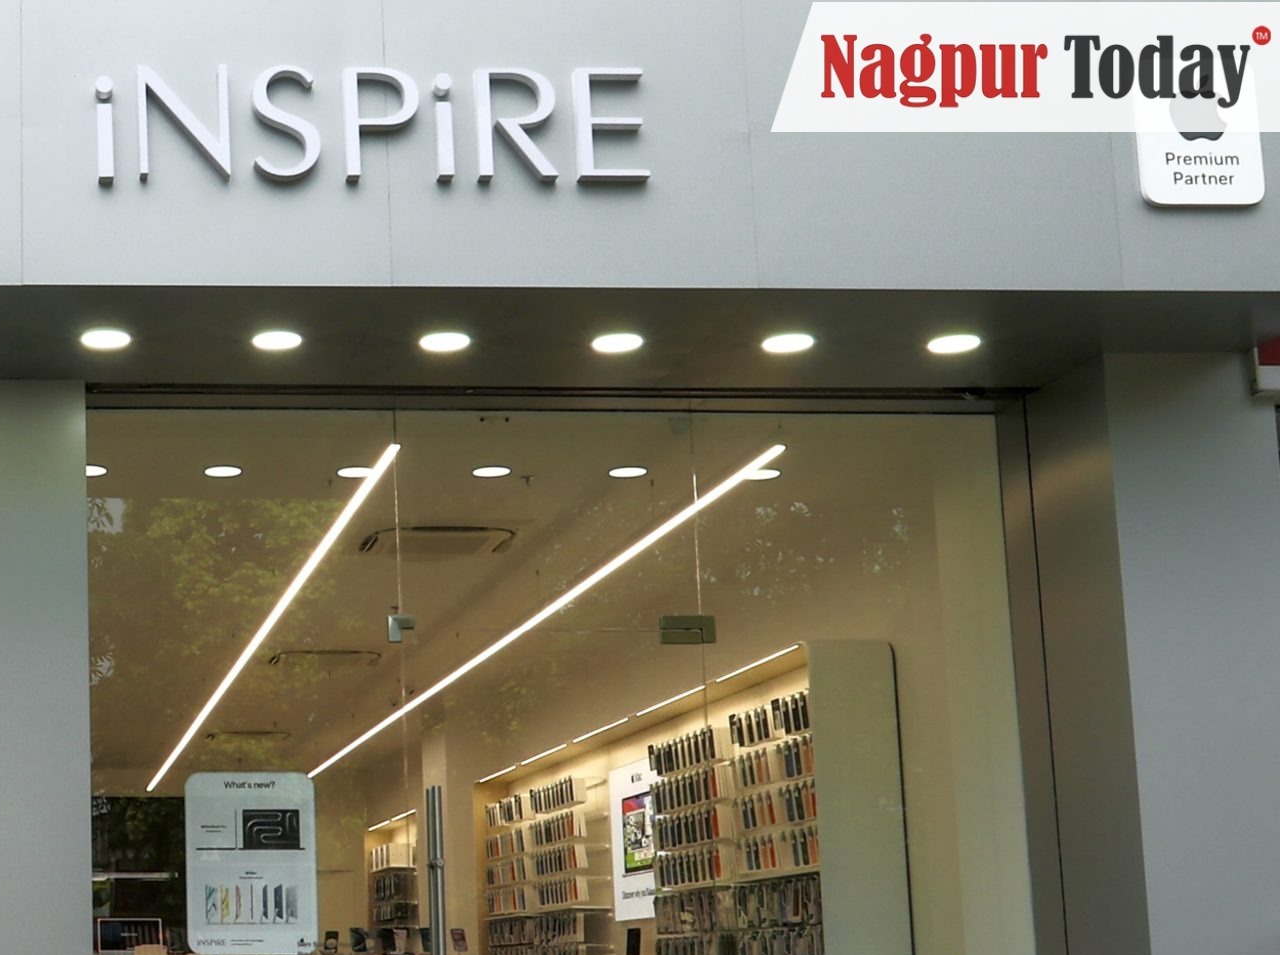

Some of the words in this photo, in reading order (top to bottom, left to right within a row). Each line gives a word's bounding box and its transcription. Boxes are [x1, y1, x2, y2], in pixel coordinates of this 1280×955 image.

[1165, 151, 1240, 166] Premium
[1173, 171, 1235, 186] Partner
[223, 780, 253, 790] What's
[253, 780, 276, 790] new?
